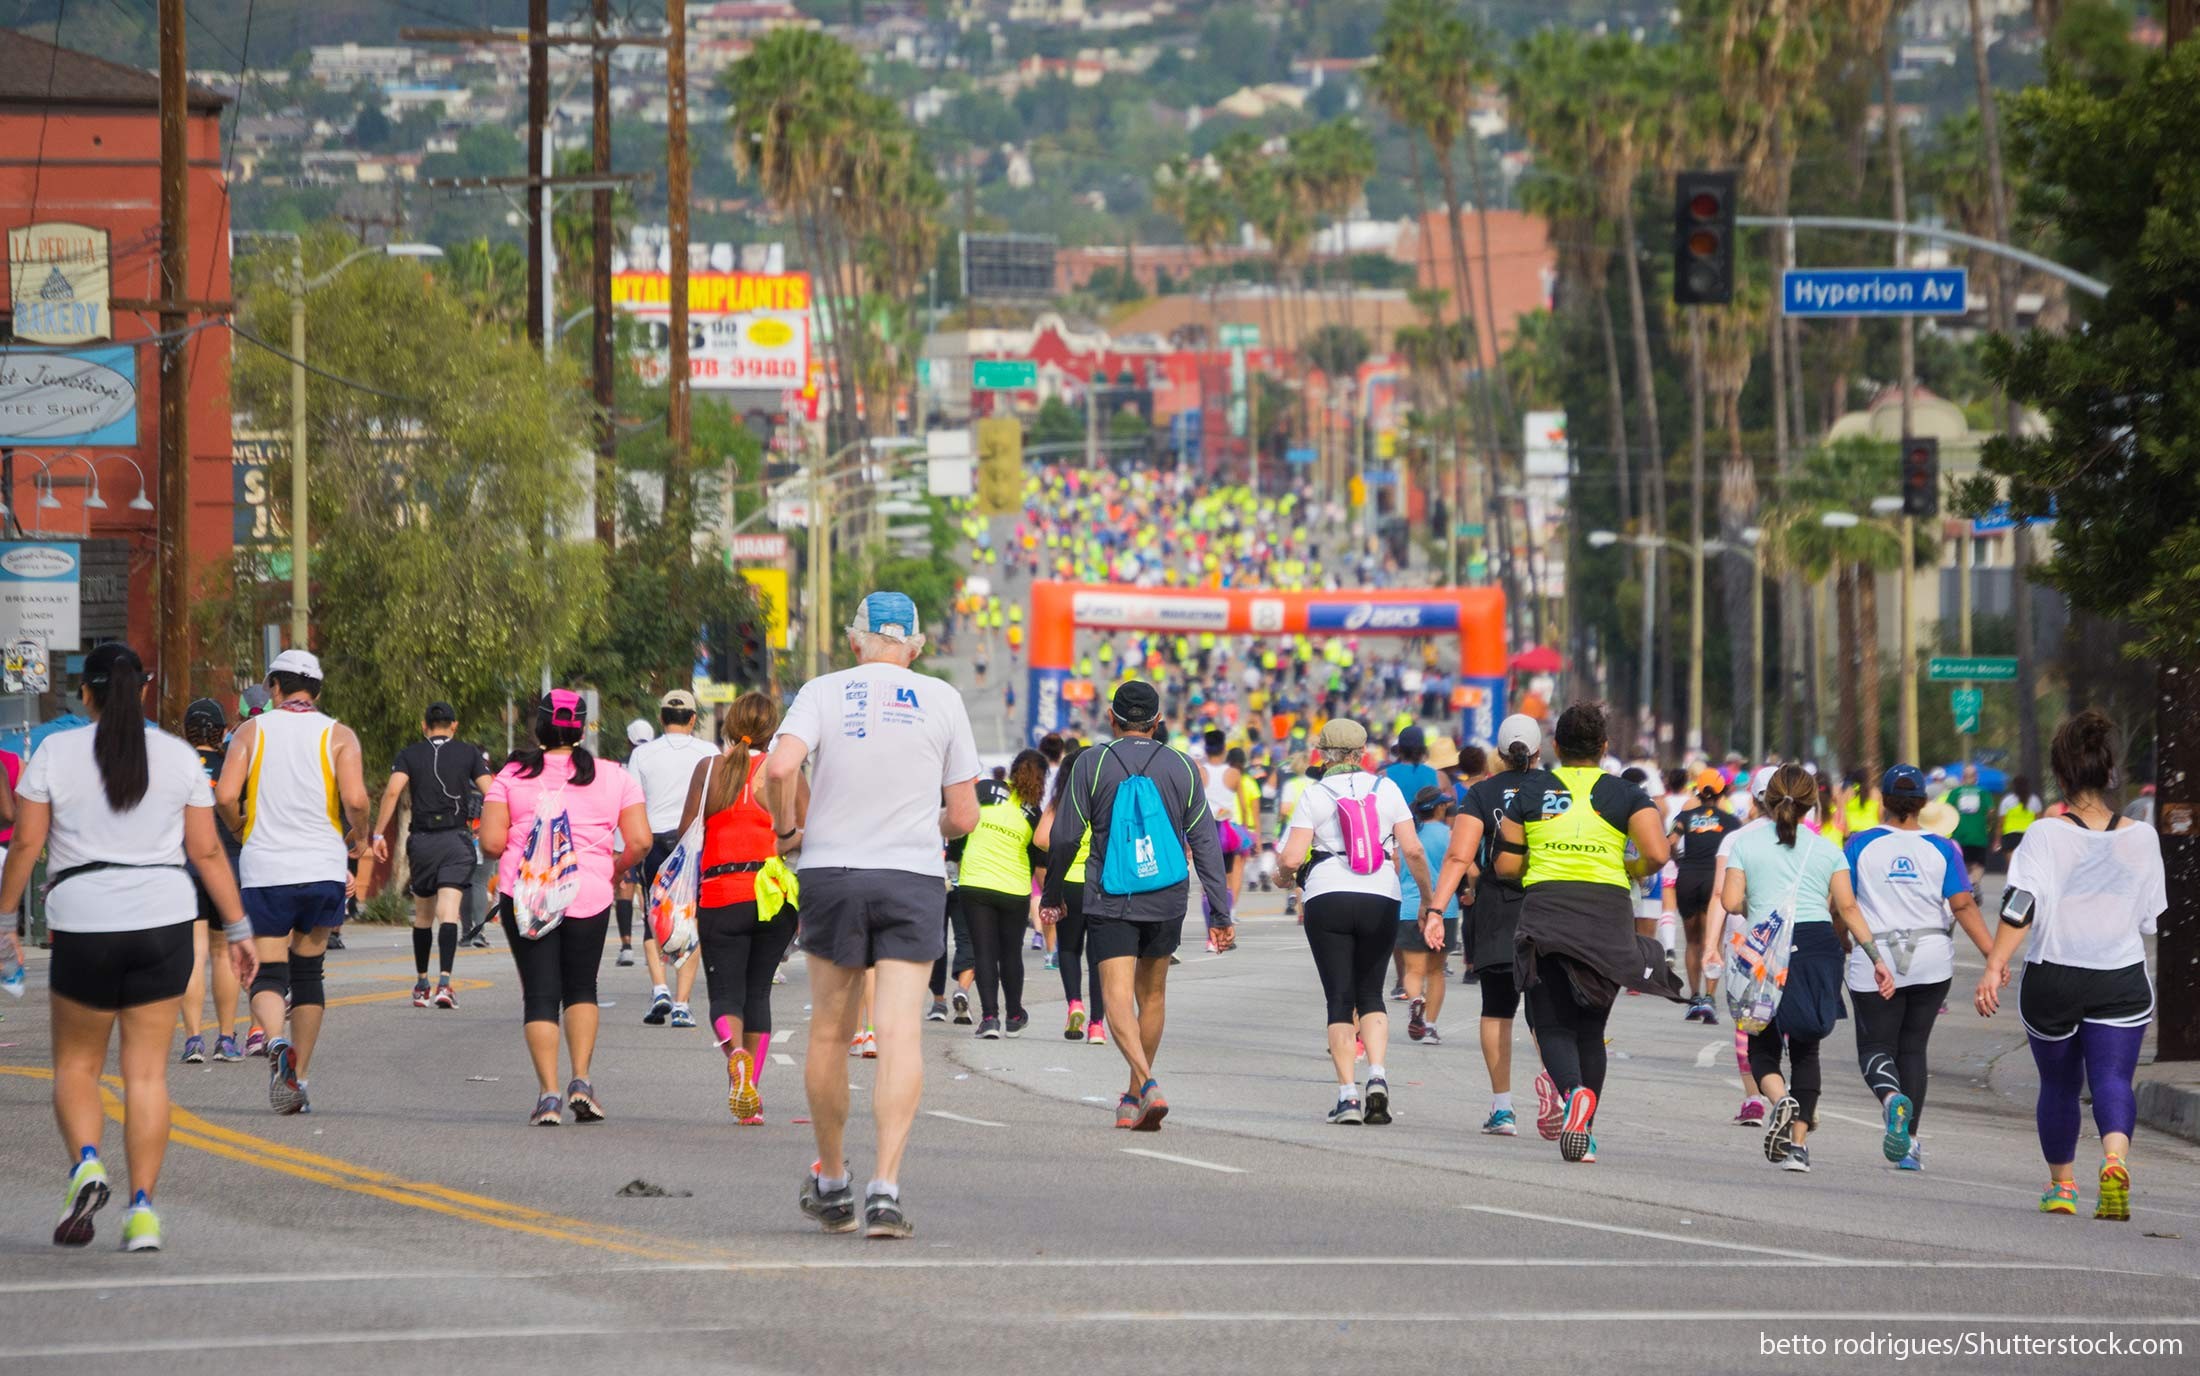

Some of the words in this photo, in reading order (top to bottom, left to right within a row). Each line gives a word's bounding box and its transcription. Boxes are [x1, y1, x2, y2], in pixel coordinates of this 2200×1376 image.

[14, 237, 32, 263] LA
[39, 237, 95, 266] PERLITA
[688, 277, 806, 311] MPLANTS
[1795, 277, 1914, 309] Hyperion
[1922, 278, 1954, 301] Av
[15, 302, 99, 335] BAKERY
[24, 364, 119, 400] Junction
[47, 404, 100, 416] SHOP
[733, 537, 785, 557] URANT
[981, 822, 1022, 842] HONDA
[1544, 842, 1608, 853] HONDA
